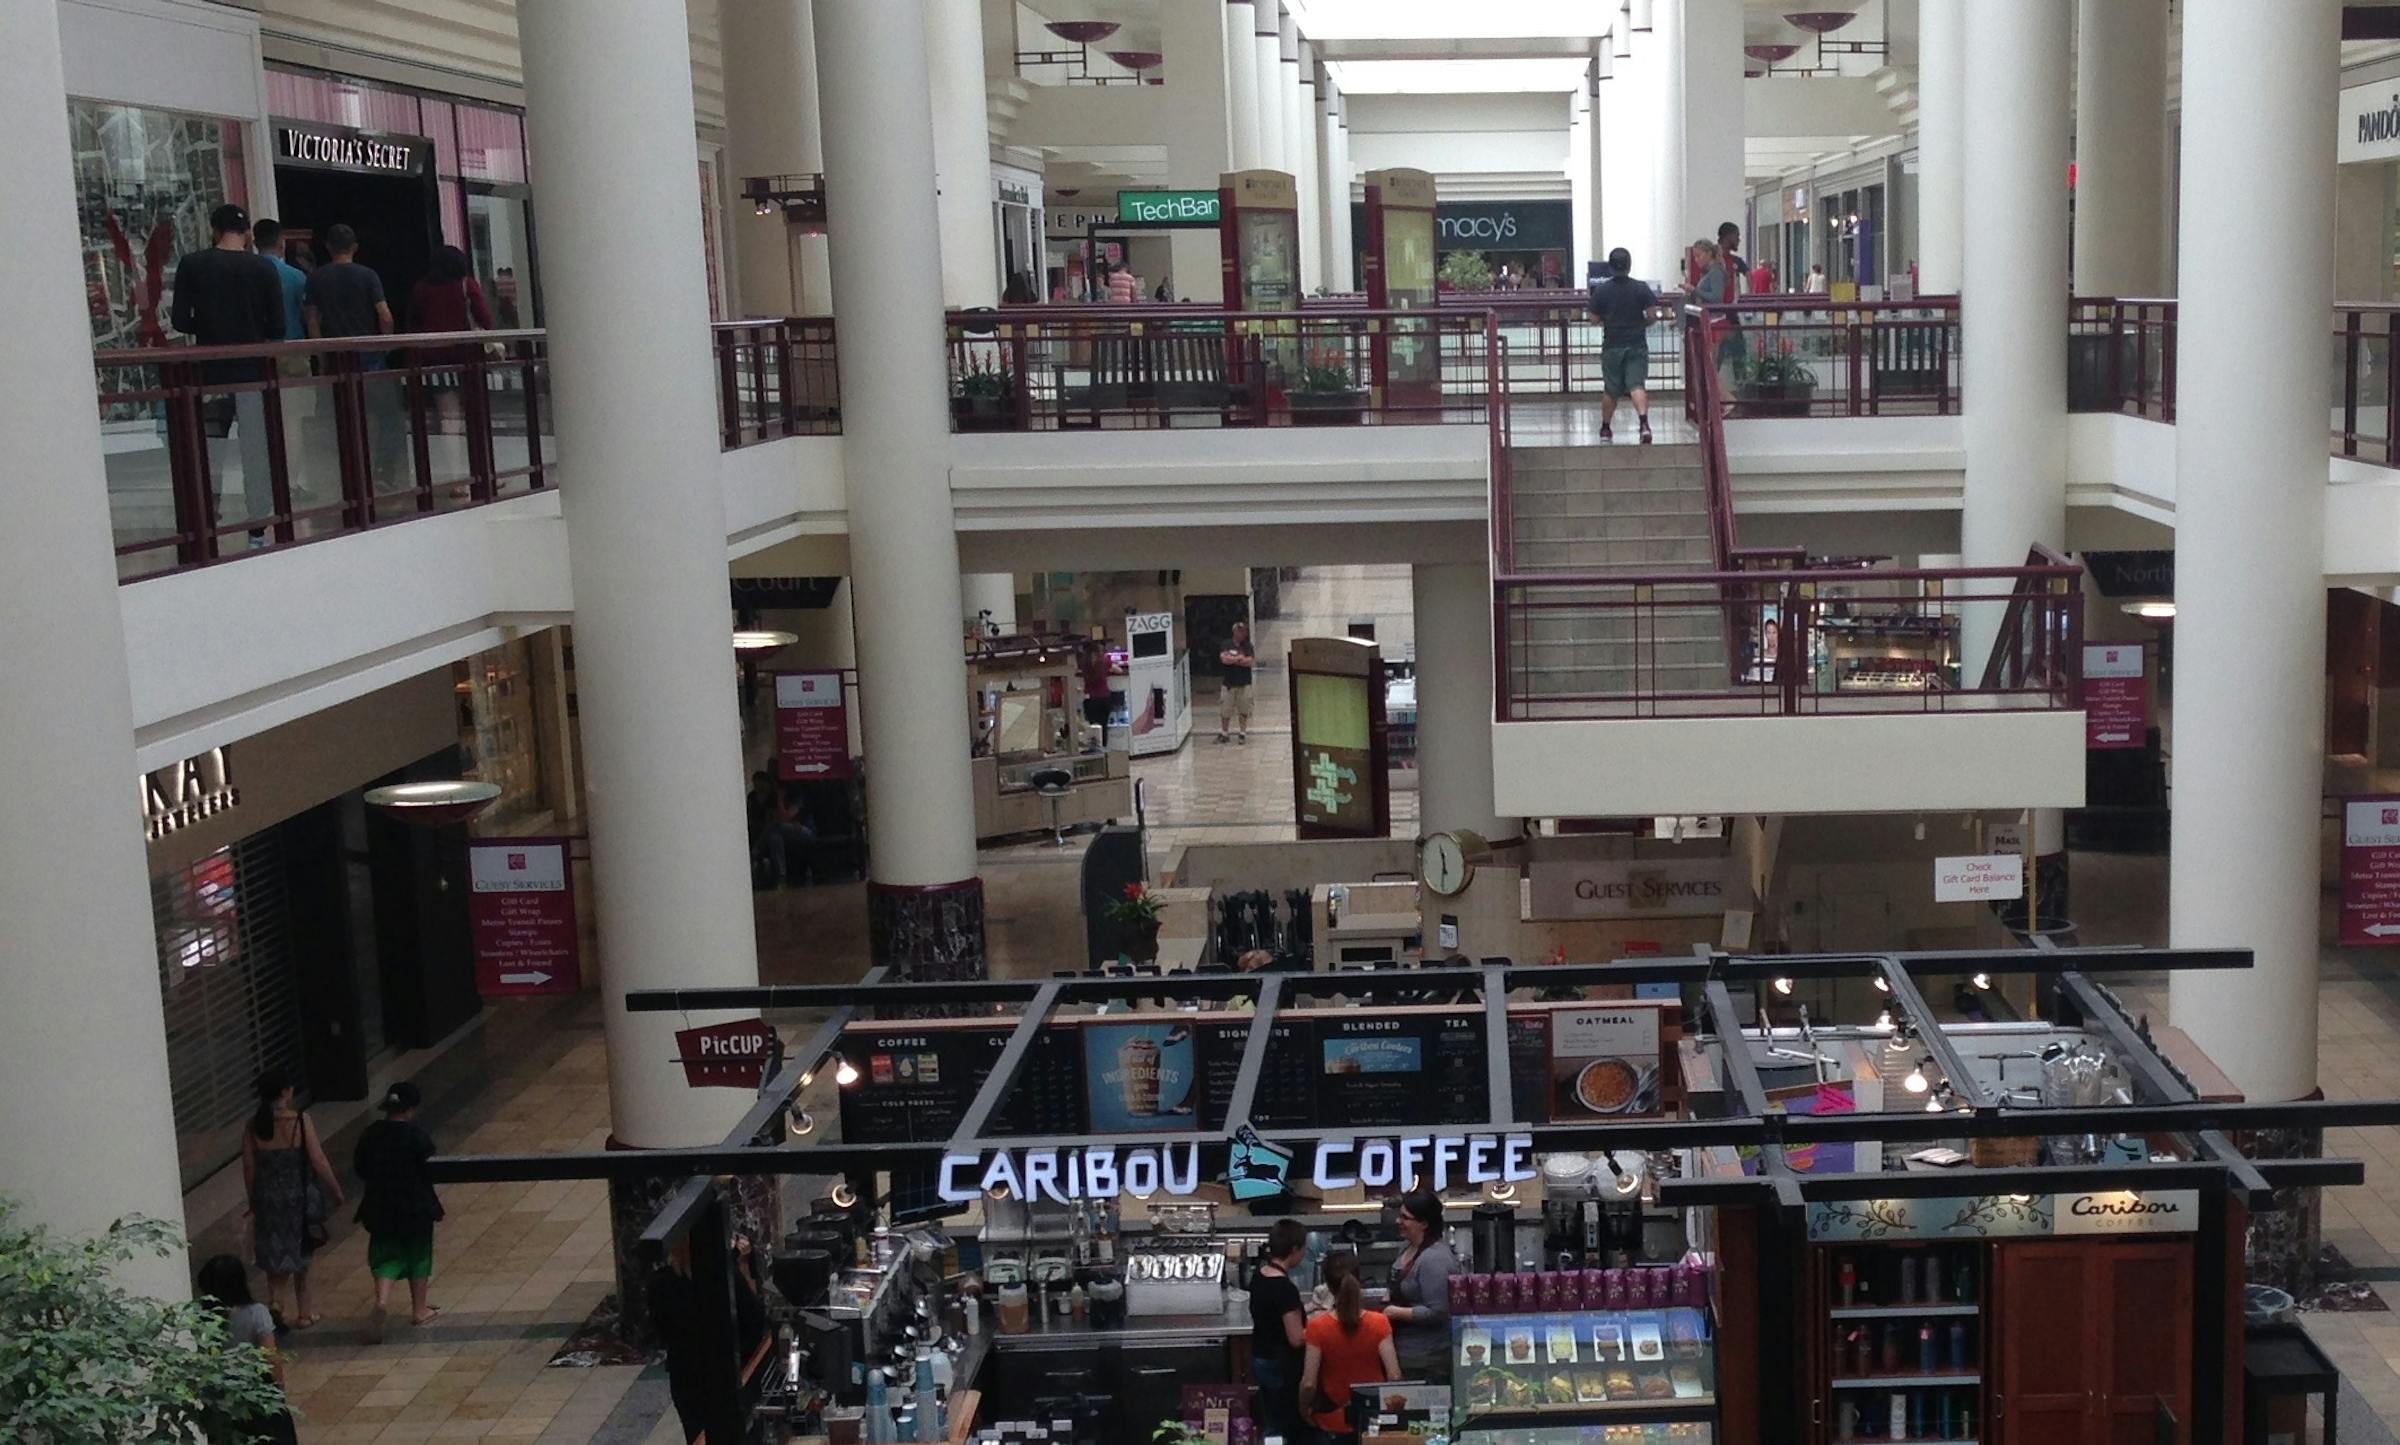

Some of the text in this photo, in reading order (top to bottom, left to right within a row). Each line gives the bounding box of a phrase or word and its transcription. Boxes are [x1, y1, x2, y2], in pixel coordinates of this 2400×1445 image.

[288, 129, 410, 170] VICTORIA'S SECRET
[1044, 213, 1120, 228] EPH
[1128, 615, 1171, 633] ZAGG
[151, 787, 240, 839] JEWELERS
[1966, 863, 1992, 872] Check
[1943, 873, 2016, 884] Gift Card Balance
[513, 879, 562, 889] SERVICES
[1575, 879, 1722, 900] GUEST SERVICES
[1969, 886, 1990, 894] Here
[519, 897, 539, 905] Card
[1343, 1021, 1401, 1031] BLENDED
[1444, 1019, 1469, 1028] TEA
[1576, 1017, 1635, 1025] OATMEAL
[1219, 1029, 1291, 1038] SIGNRE
[700, 1034, 763, 1055] PicCUP
[878, 1037, 928, 1047] COFFEE
[1102, 1067, 1180, 1084] INGREDIENTS
[938, 1137, 1538, 1205] CARIBOU COFFEE
[2071, 1195, 2179, 1216] Caribou
[2096, 1218, 2154, 1227] COFFEE
